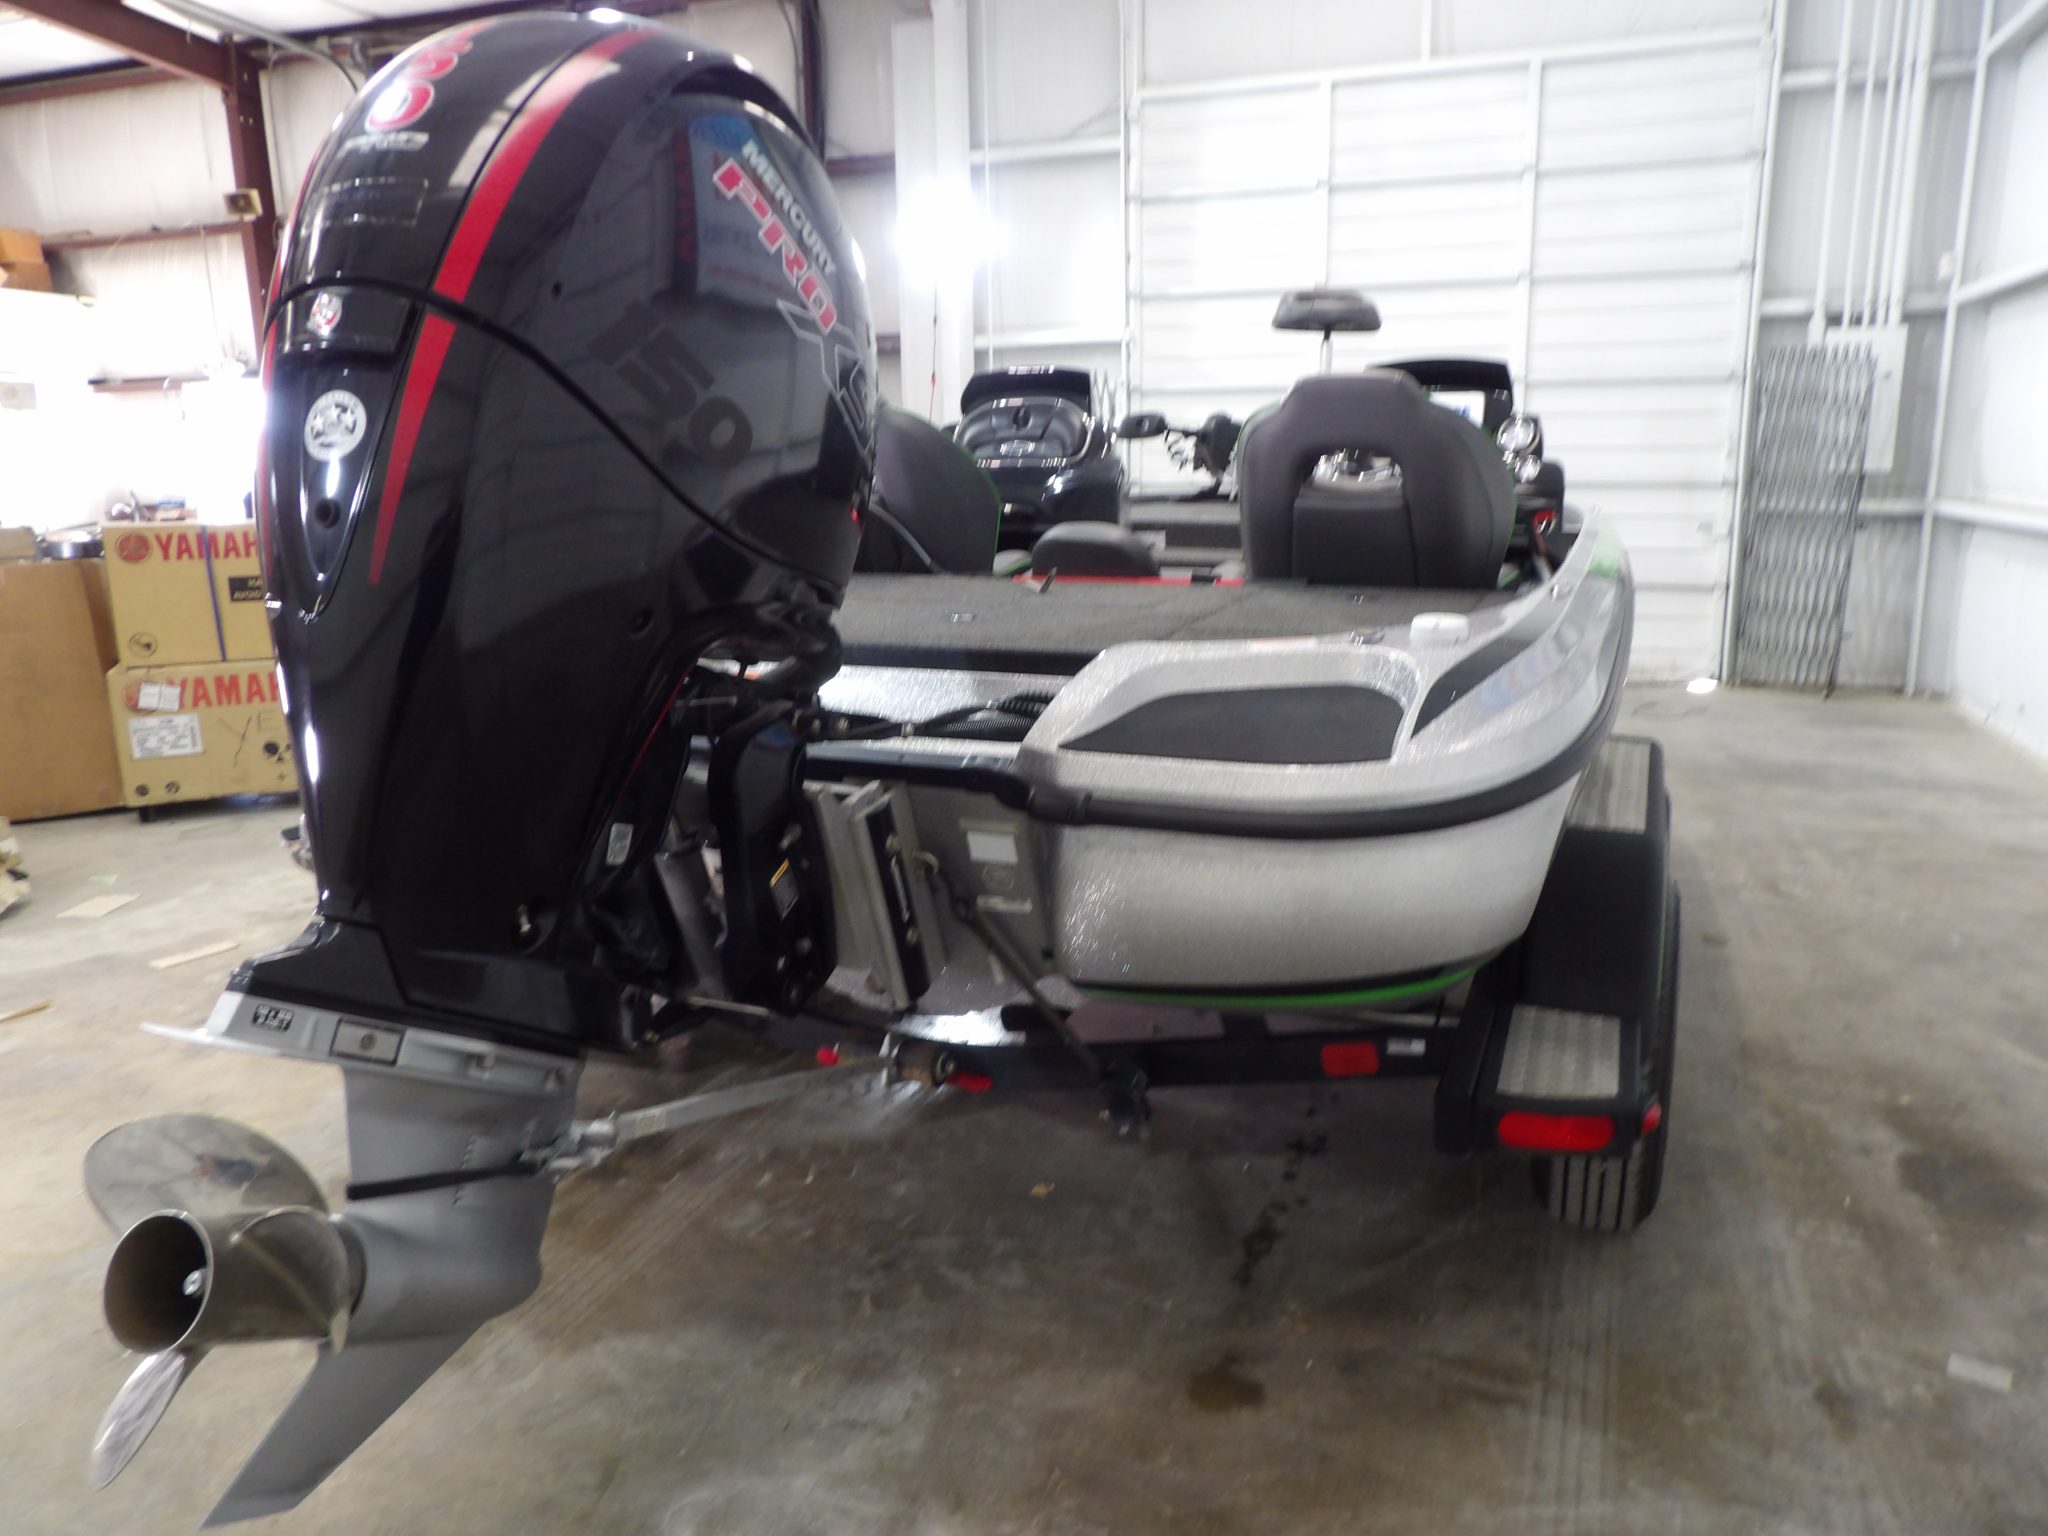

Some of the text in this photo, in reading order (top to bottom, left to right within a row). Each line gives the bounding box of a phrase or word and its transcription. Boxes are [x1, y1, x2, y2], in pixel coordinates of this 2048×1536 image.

[713, 157, 838, 335] PRO
[741, 138, 837, 275] MERCURY
[153, 530, 258, 561] YAMAH
